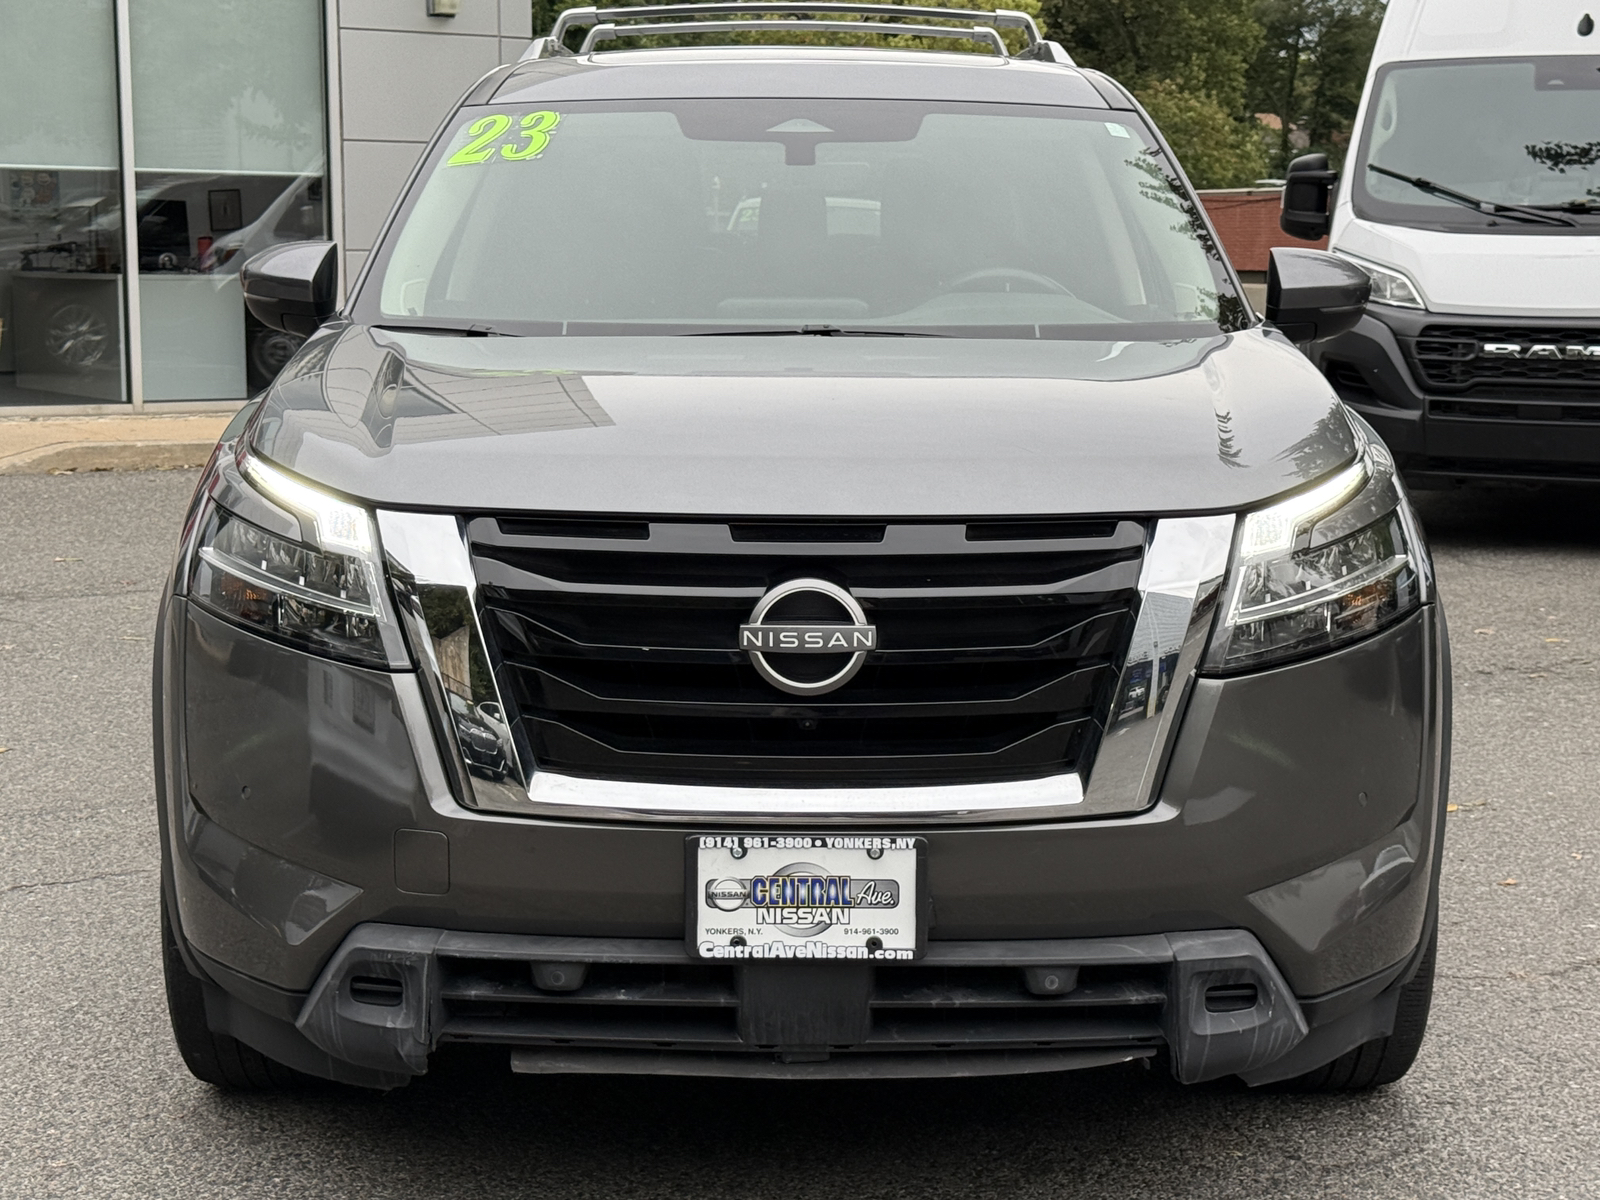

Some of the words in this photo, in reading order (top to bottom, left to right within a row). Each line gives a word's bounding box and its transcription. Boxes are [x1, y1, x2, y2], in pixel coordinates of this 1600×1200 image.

[447, 110, 560, 166] 23
[743, 631, 872, 648] NISSAN
[743, 837, 812, 849] 961-3900
[751, 876, 855, 907] CENTRAL
[756, 907, 850, 924] NISSAN
[705, 928, 746, 936] YONKERS,
[699, 941, 914, 960] CentralAveNissan.com
